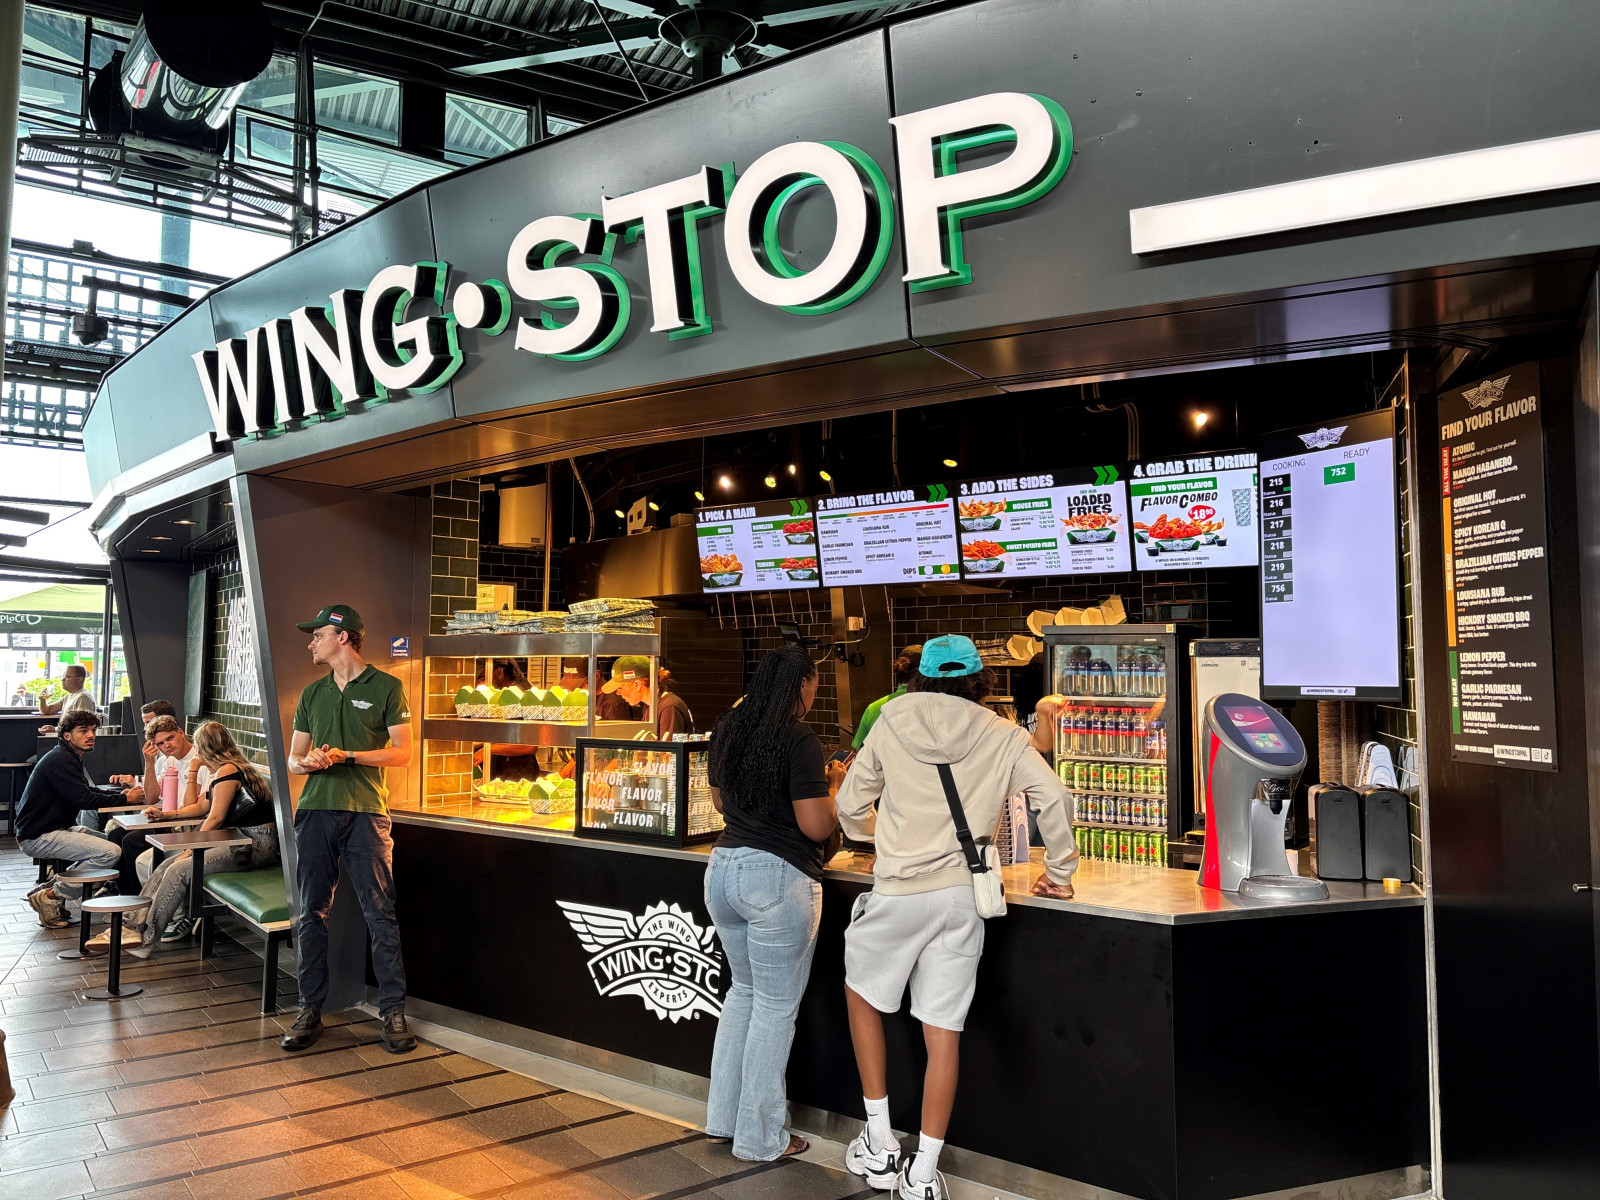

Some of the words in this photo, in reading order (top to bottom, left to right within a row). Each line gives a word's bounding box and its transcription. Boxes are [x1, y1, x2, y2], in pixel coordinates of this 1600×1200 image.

[1441, 420, 1463, 441] FIND
[1464, 410, 1493, 433] YOUR
[1494, 395, 1537, 424] FLAVOR
[1343, 447, 1370, 460] READY
[1452, 441, 1476, 457] ATOMIC
[1146, 460, 1185, 476] GRAB
[1186, 457, 1213, 472] THE
[1272, 457, 1306, 472] COOKING
[1330, 466, 1346, 477] 752
[1452, 466, 1476, 480] MANGO
[1476, 455, 1513, 474] HABANERO
[960, 483, 970, 496] 3.
[972, 480, 995, 494] ADD
[996, 478, 1018, 491] THE
[1019, 474, 1054, 489] SIDES
[1151, 484, 1167, 493] FIND
[1167, 483, 1186, 491] YOUR
[1186, 480, 1214, 490] FLAVOR
[1268, 477, 1283, 487] 215
[817, 499, 826, 511] 2.
[826, 496, 856, 509] BRING
[857, 494, 875, 505] THE
[876, 489, 915, 503] FLAVOR
[1067, 493, 1111, 507] LOADED
[1269, 498, 1284, 509] 216
[1453, 493, 1482, 508] ORIGINAL
[1483, 488, 1497, 501] HOT
[705, 510, 725, 522] PICK
[725, 509, 733, 520] A
[733, 506, 757, 519] MAIN
[1068, 504, 1112, 520] FRIES
[1269, 519, 1284, 530] 217
[1454, 525, 1473, 539] SPICY
[1473, 521, 1500, 536] KOREAN
[1500, 519, 1507, 530] Q
[1270, 541, 1285, 551] 218
[1492, 550, 1517, 564] CITRUS
[1517, 546, 1544, 560] PEPPER
[1270, 562, 1285, 572] 219
[1271, 583, 1286, 593] 756
[1456, 588, 1491, 601] LOUISIANA
[1491, 586, 1506, 597] RUB
[1457, 614, 1486, 626] HICKORY
[1486, 612, 1515, 624] SMOKED
[1515, 610, 1531, 622] BBQ
[1459, 652, 1481, 662] LEMON
[1481, 651, 1506, 662] PEPPER
[1461, 683, 1484, 694] GARLIC
[1484, 683, 1522, 695] PARMESAN
[1452, 697, 1458, 708] NO
[585, 769, 624, 786] FLAVOR
[633, 762, 673, 777] FLAVOR
[621, 786, 662, 802] FLAVOR
[613, 811, 654, 828] FLAVOR
[647, 920, 664, 936] THE
[667, 919, 692, 943] WING
[647, 981, 689, 1004] EXPERTS
